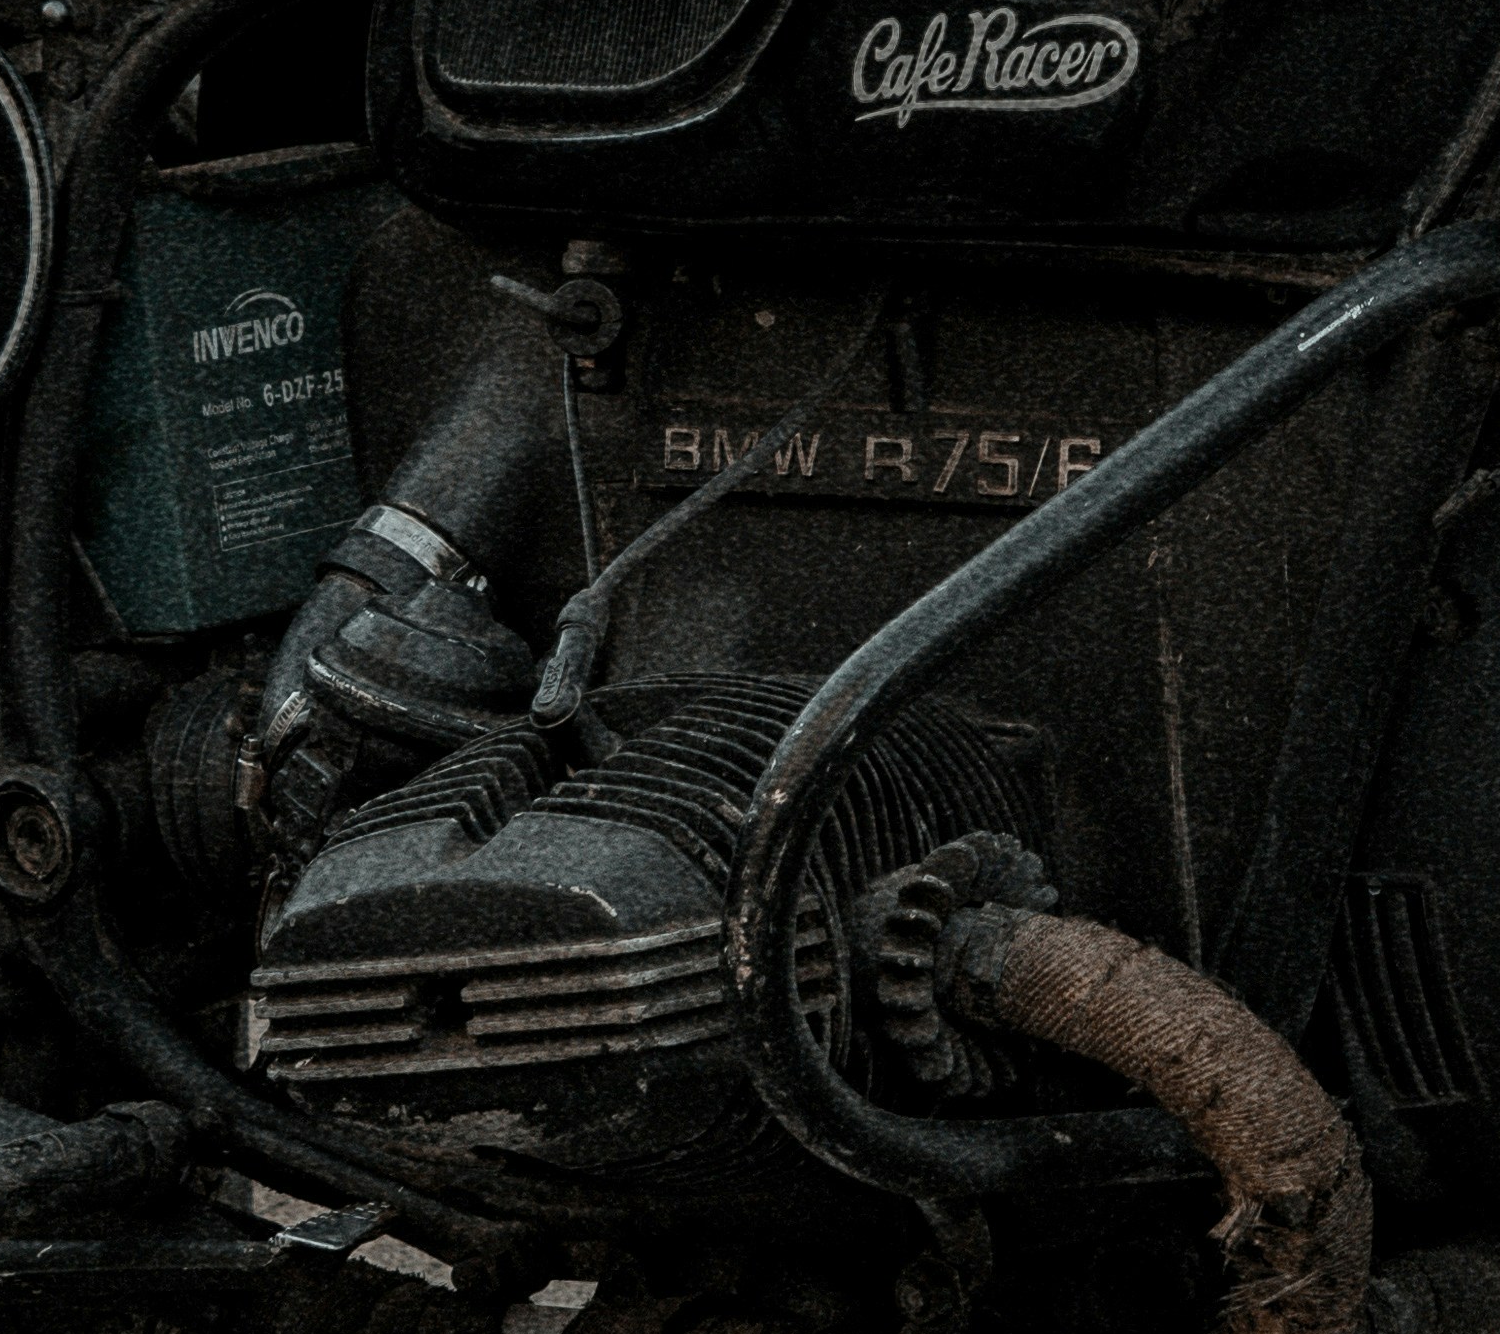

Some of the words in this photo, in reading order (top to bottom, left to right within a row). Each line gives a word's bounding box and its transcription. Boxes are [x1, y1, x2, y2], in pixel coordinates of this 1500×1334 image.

[853, 13, 956, 128] Cafe
[952, 7, 1136, 101] Racer
[193, 311, 305, 363] INVENCO
[202, 398, 234, 417] Model
[263, 368, 345, 407] 6-DZF-25
[664, 427, 821, 478] BMW
